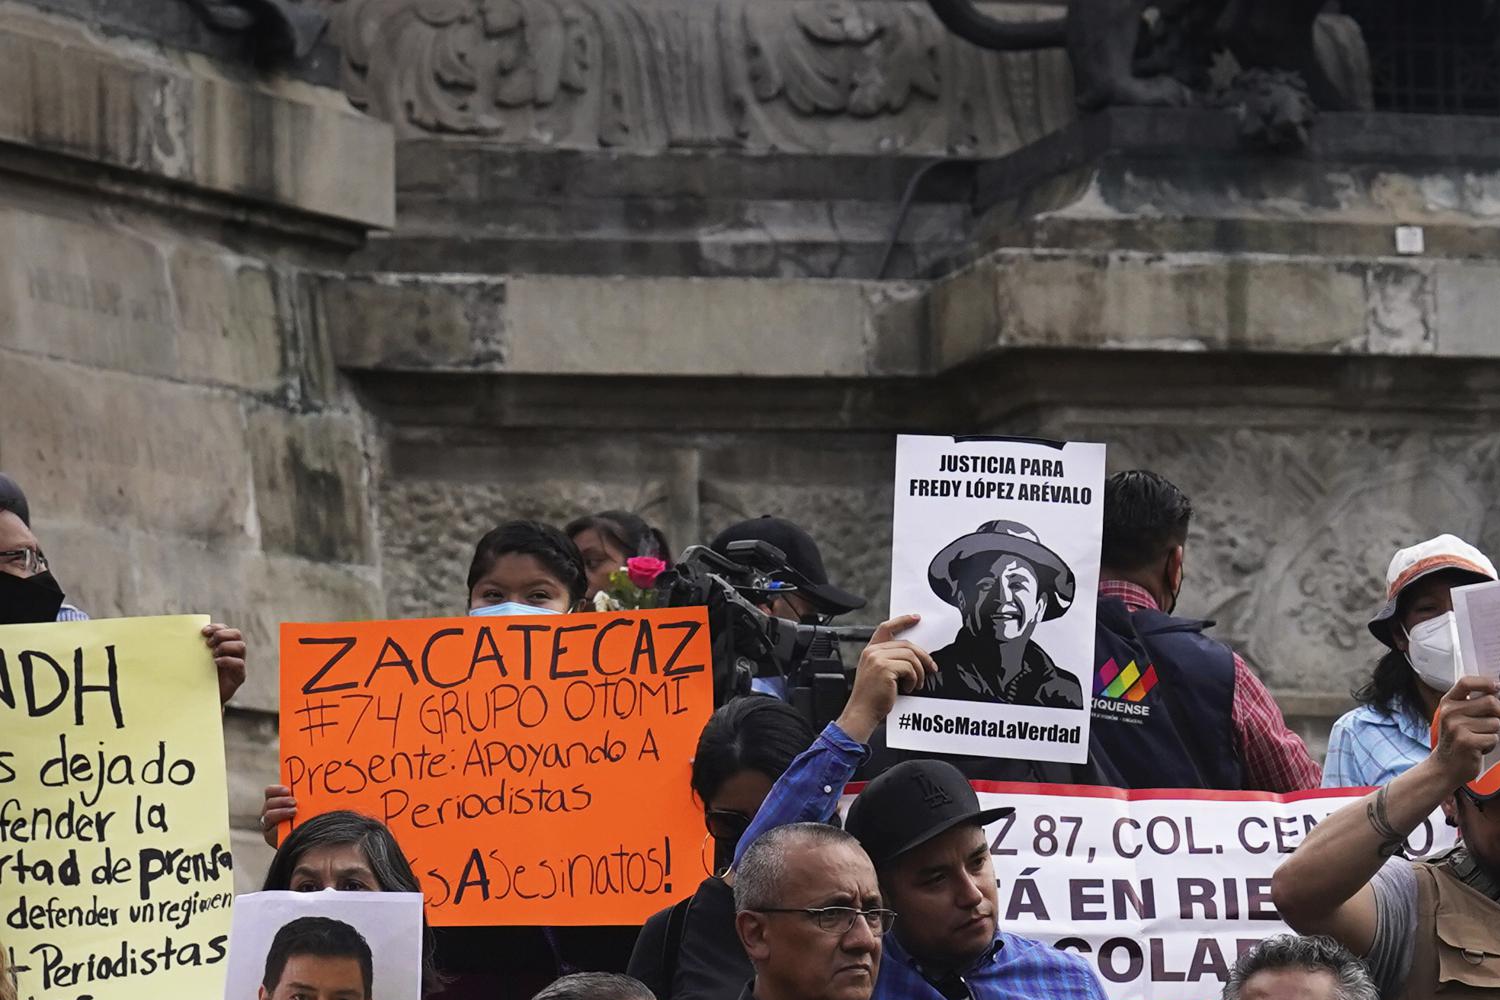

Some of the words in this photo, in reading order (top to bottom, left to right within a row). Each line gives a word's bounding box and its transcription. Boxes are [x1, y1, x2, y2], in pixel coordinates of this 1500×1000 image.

[939, 454, 1016, 475] JUSTICIA
[1020, 458, 1065, 478] PARA
[909, 478, 962, 498] FREDY
[965, 477, 1015, 500] LÓPEZ
[1017, 481, 1092, 506] ARÉVALO
[298, 618, 706, 695] ZACATECAZ
[294, 692, 403, 748] #74
[419, 683, 548, 745] GRUPO
[898, 713, 1082, 744] #NoSeMataLaVerdad
[638, 727, 660, 761] A
[40, 733, 196, 807] dejado
[135, 795, 169, 834] la
[380, 778, 592, 829] Periodistas
[989, 812, 1018, 856] Z
[1112, 815, 1223, 859] COL.
[91, 847, 132, 886] de
[6, 894, 120, 930] defender
[1068, 877, 1158, 921] EN
[1176, 877, 1283, 921] RIE
[30, 934, 228, 990] Periodistas
